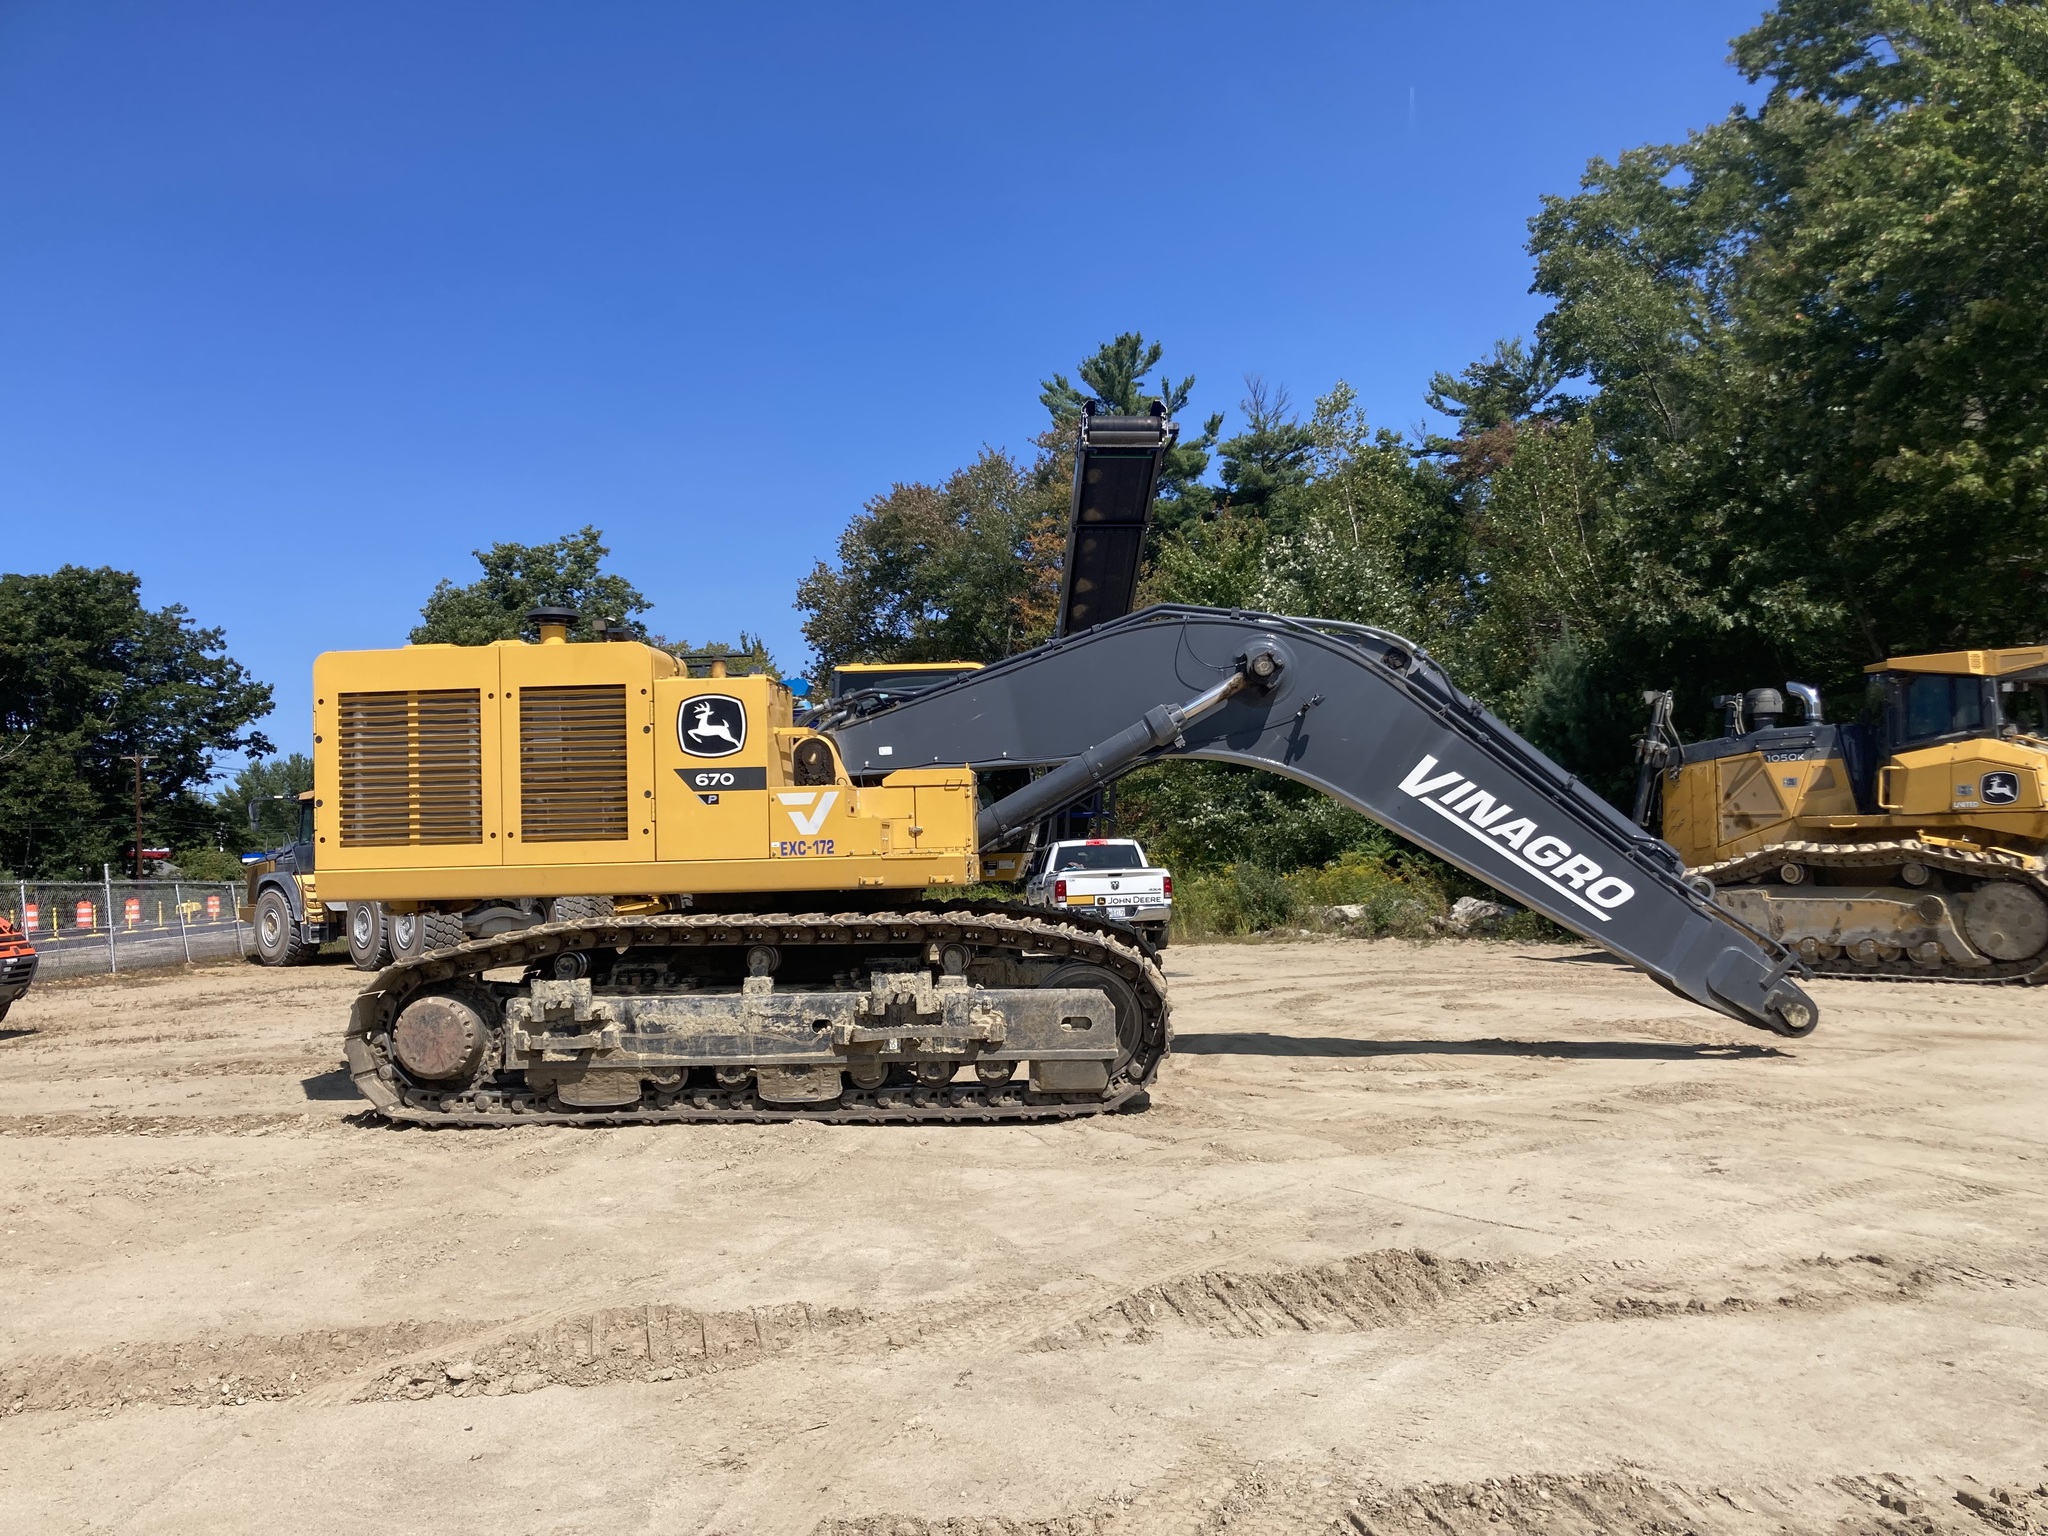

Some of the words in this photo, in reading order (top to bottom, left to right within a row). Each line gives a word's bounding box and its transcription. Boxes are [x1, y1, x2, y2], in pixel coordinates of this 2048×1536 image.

[1766, 753, 1805, 763] 1050K
[695, 773, 735, 786] 670
[707, 795, 718, 804] P
[1397, 754, 1636, 909] VINAGRO
[780, 839, 835, 857] EXC-172
[1107, 897, 1132, 905] JOHN
[1133, 895, 1162, 904] DEERE
